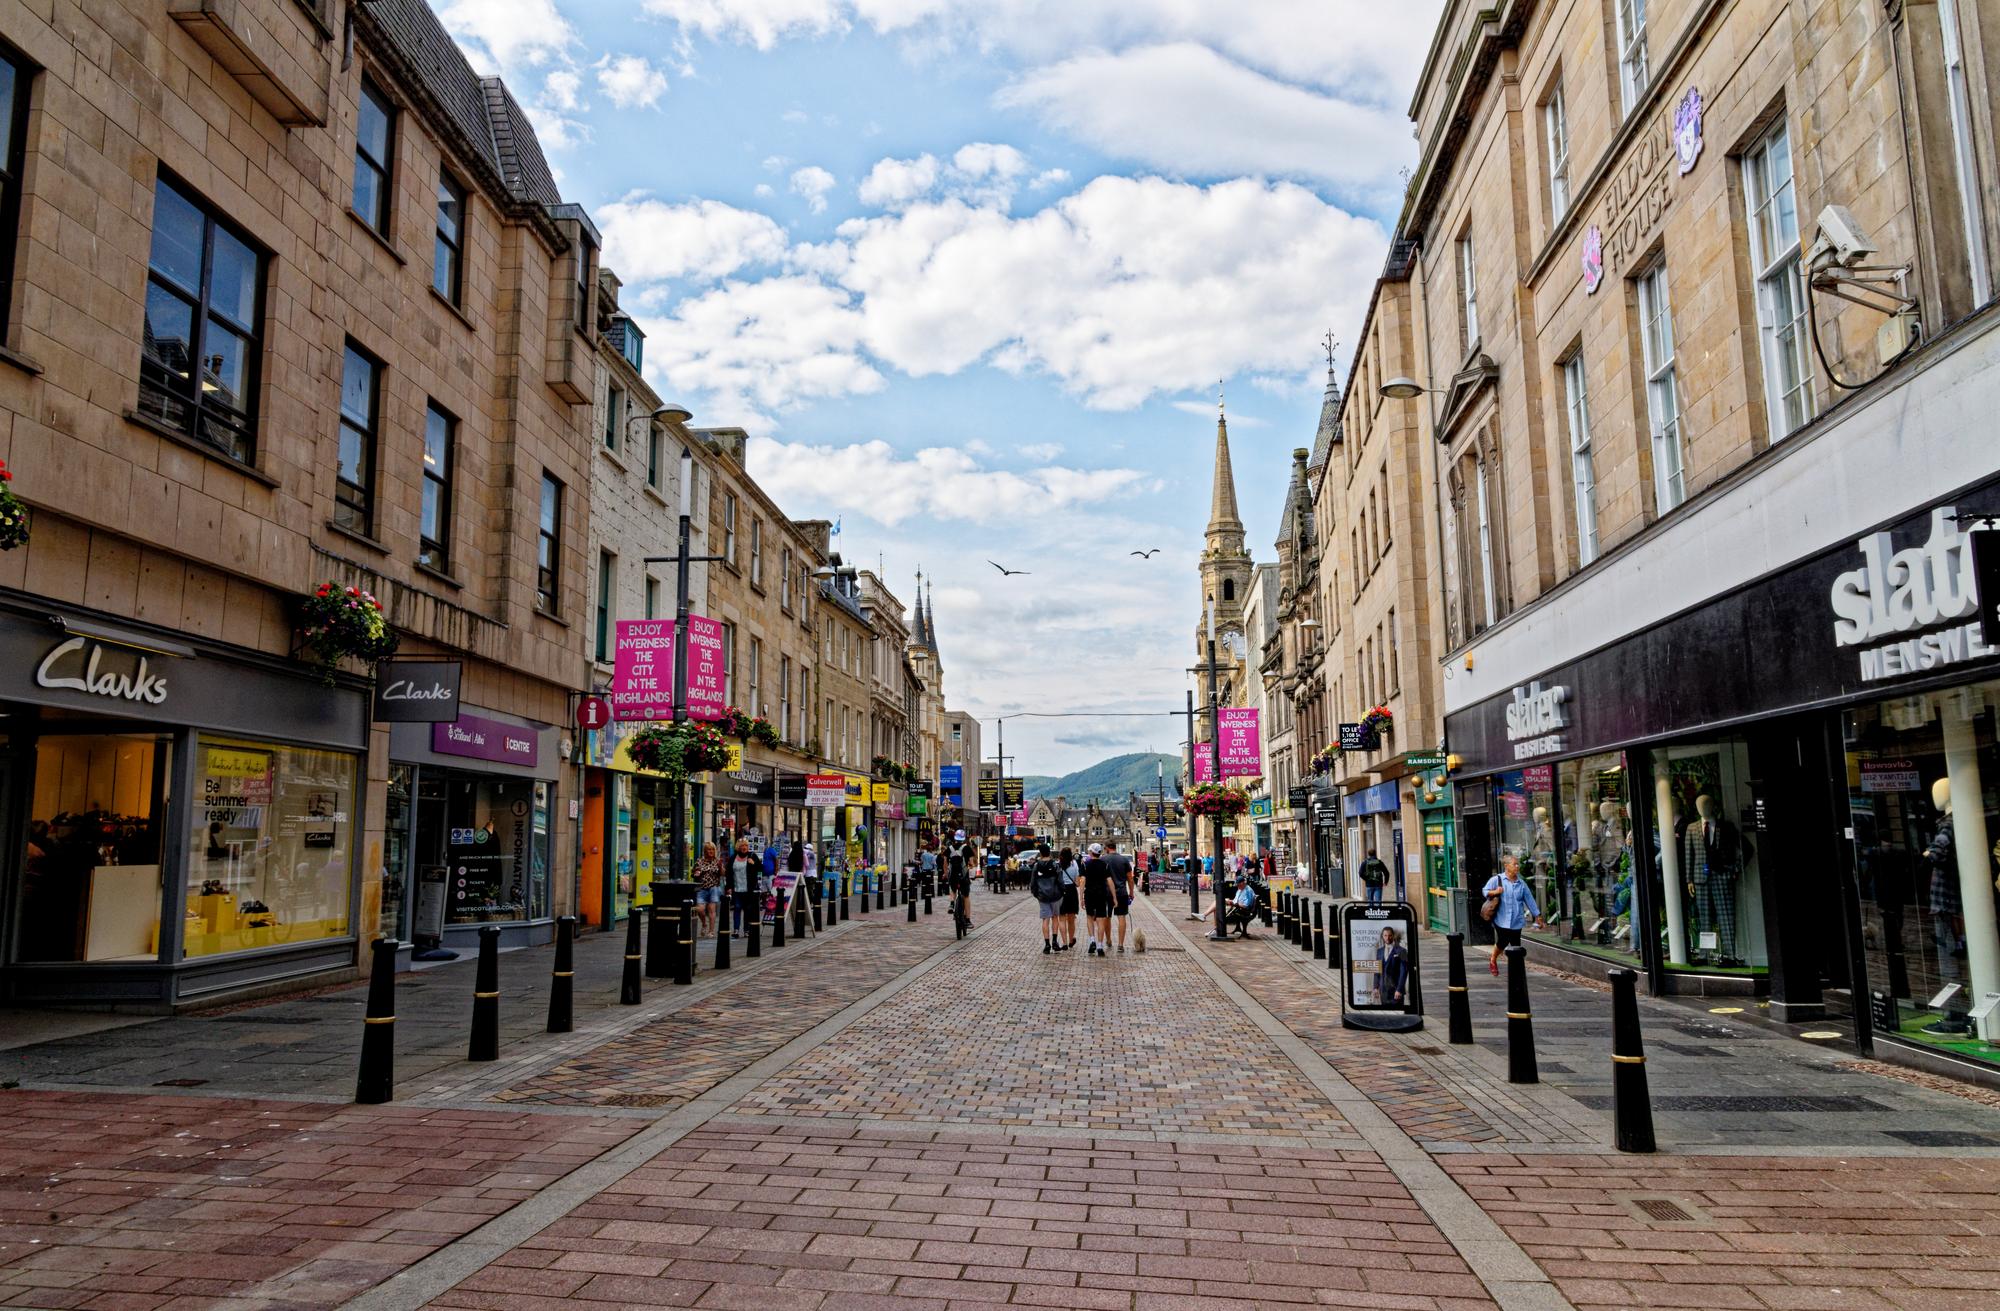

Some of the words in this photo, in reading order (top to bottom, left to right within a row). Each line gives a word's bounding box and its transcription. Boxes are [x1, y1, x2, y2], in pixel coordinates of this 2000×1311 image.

[1606, 111, 1669, 228] EILDON
[1612, 170, 1673, 273] HOUSE
[628, 624, 662, 636] ENJOY
[694, 621, 714, 635] ENJOY
[619, 638, 670, 649] INVERNESS
[690, 632, 721, 649] INVERNESS
[634, 651, 653, 662] THE
[701, 648, 712, 660] THE
[1859, 621, 1996, 682] MENSWE
[36, 637, 167, 704] Clarks
[632, 664, 654, 676] CITY
[700, 662, 714, 674] CITY
[628, 678, 638, 689] IN
[640, 678, 658, 689] THE
[696, 675, 704, 686] IN
[705, 676, 716, 688] THE
[382, 680, 452, 700] Clarks
[688, 687, 723, 703] HIGHLANDS
[614, 692, 670, 704] HIGHLANDS
[1506, 681, 1563, 742] slater
[1514, 735, 1560, 760] MENSWEAR
[206, 780, 219, 793] Be
[205, 796, 248, 807] summer
[205, 808, 236, 825] ready
